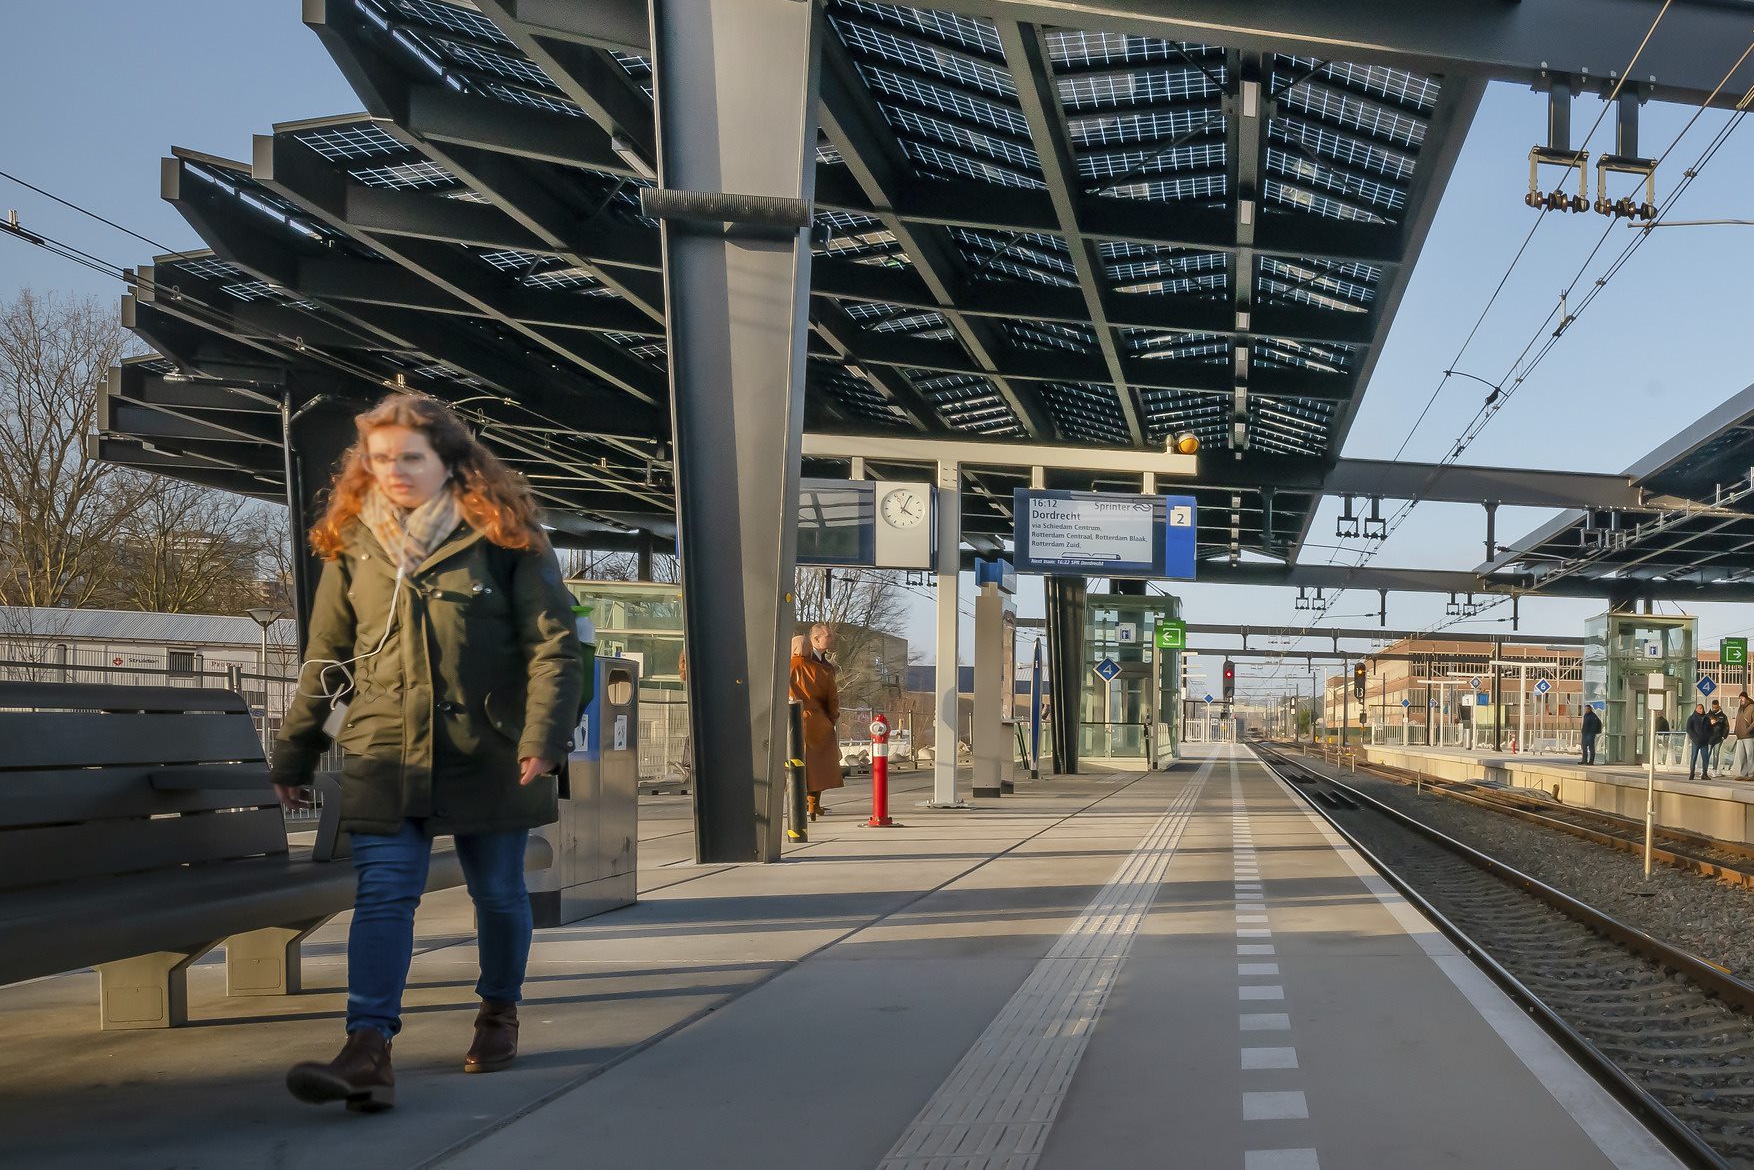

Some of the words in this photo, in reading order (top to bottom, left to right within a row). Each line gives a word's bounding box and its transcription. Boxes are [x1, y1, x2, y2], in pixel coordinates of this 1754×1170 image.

[1094, 502, 1130, 511] Sprinter
[1032, 510, 1080, 520] Dordrecht
[1176, 513, 1184, 524] 2
[1103, 664, 1112, 675] 4
[1702, 681, 1711, 691] 4
[1356, 687, 1364, 697] 13
